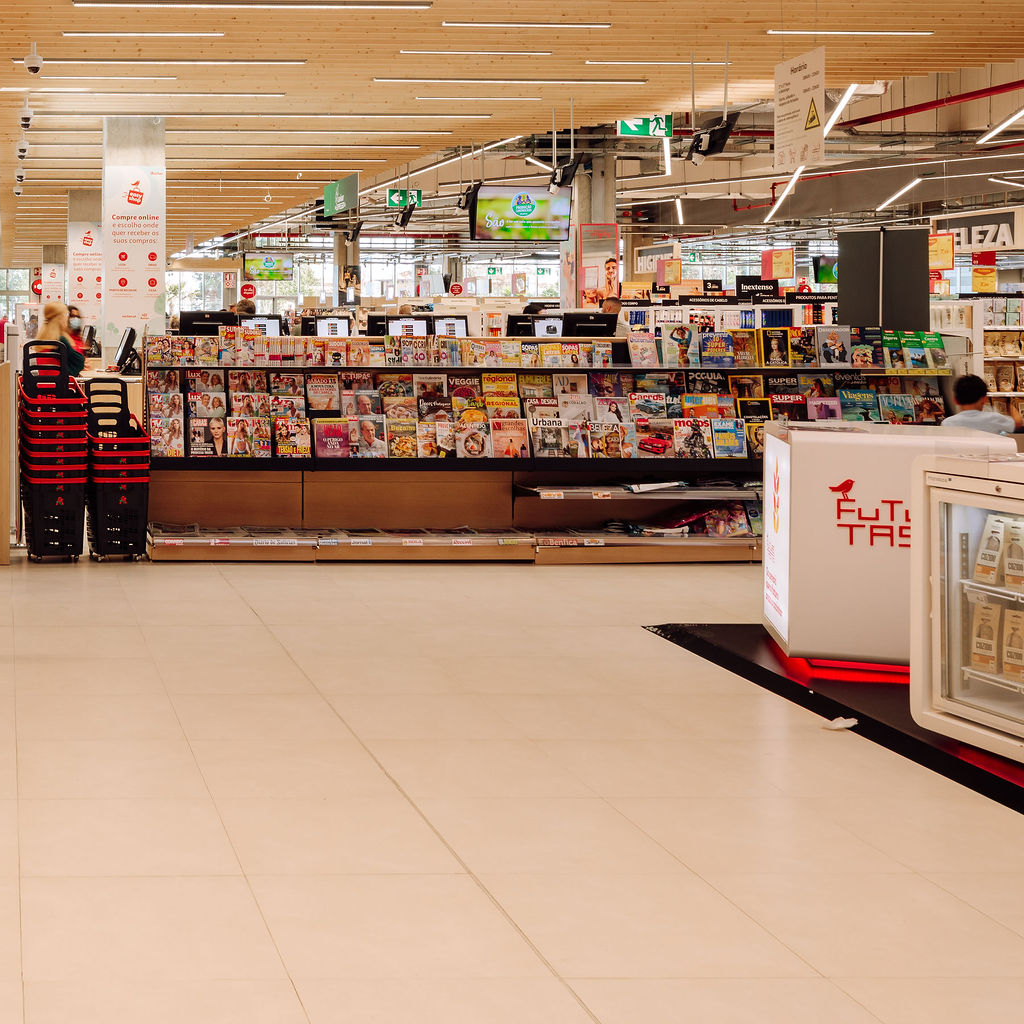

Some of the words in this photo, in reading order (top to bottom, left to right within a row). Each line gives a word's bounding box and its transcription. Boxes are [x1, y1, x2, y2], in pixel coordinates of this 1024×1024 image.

[741, 283, 774, 291] Inextenso
[483, 375, 515, 383] regional
[629, 393, 664, 401] Carros
[841, 390, 874, 400] Viagens
[532, 418, 562, 427] Urbana
